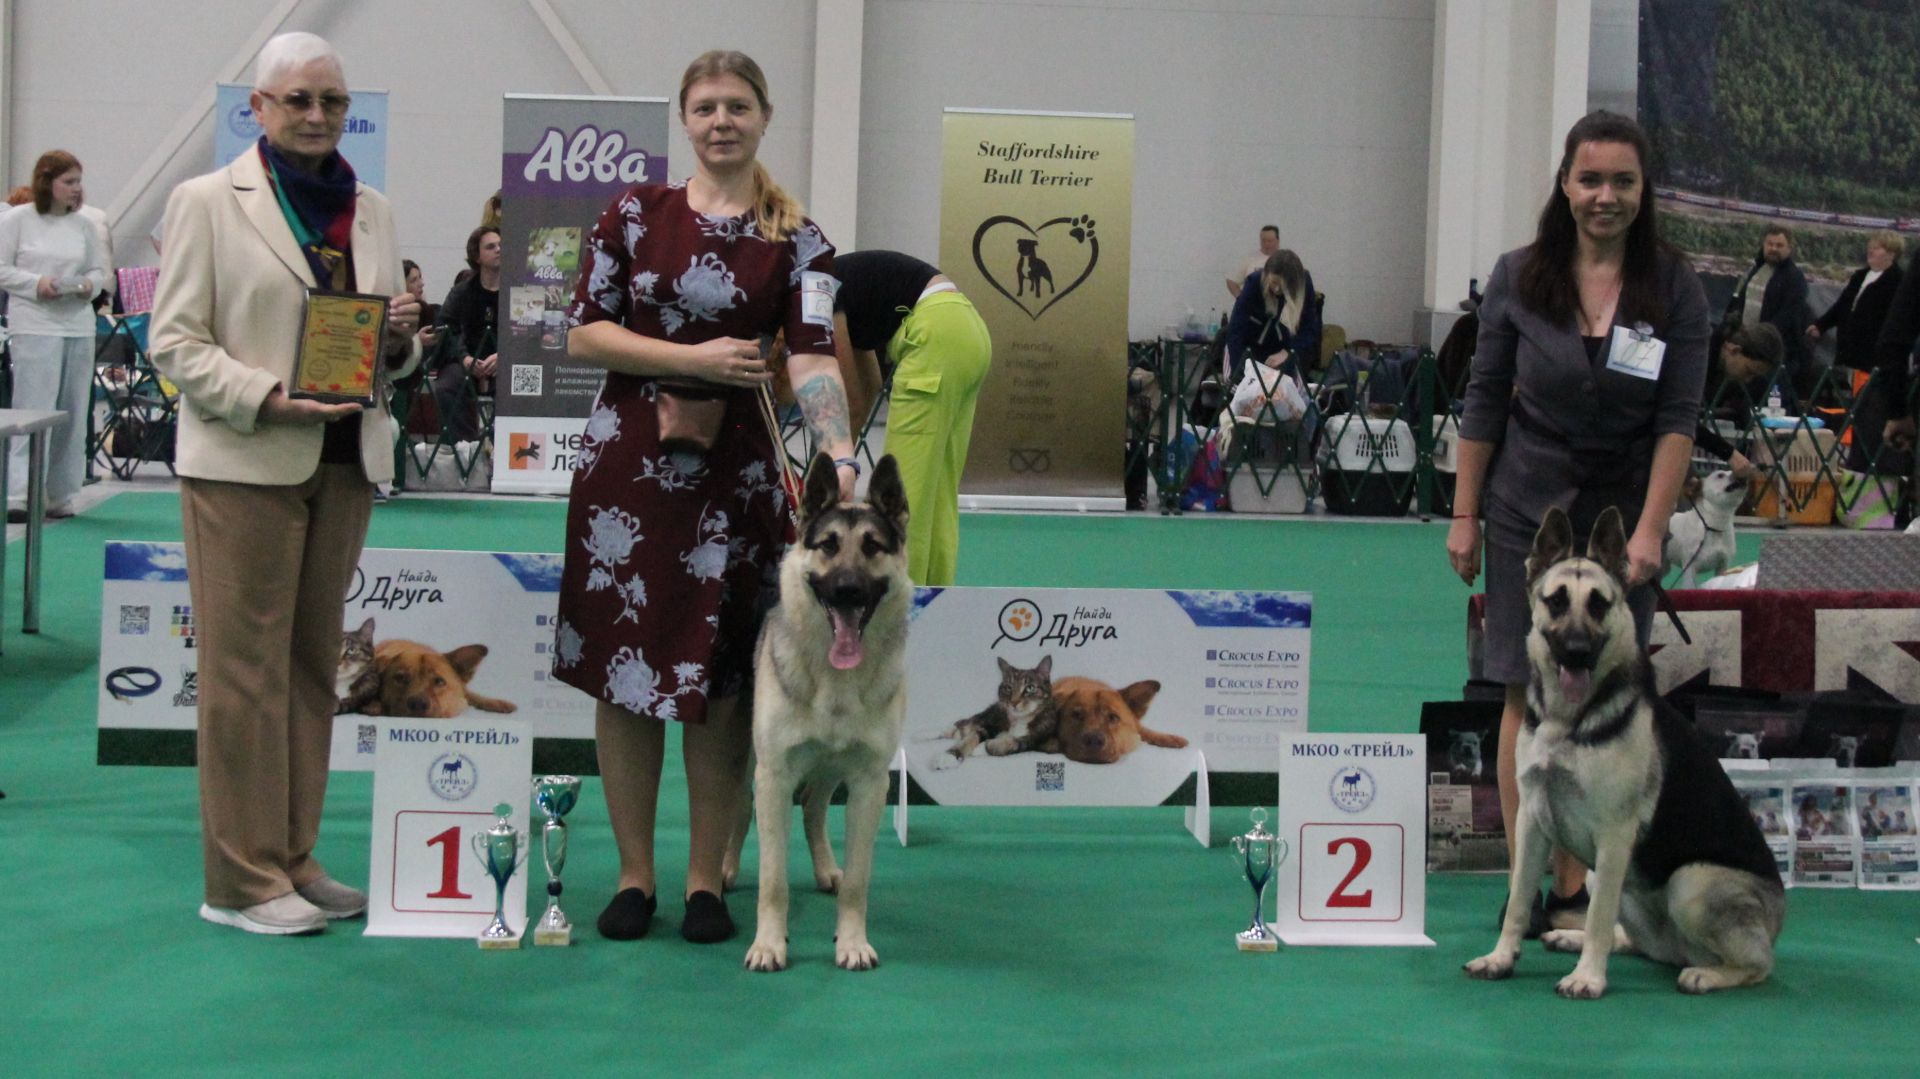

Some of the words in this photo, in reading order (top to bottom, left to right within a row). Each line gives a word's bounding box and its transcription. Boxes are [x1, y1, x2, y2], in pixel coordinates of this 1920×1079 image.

[343, 117, 376, 134] ЕЙЛ»
[524, 127, 649, 183] Авва
[977, 140, 1100, 161] Staffordshire
[983, 167, 1023, 185] Bull
[1029, 168, 1094, 187] Terrier
[553, 433, 584, 451] че
[551, 454, 578, 472] ла
[397, 568, 438, 583] Найди
[361, 576, 443, 610] Друга
[1073, 606, 1112, 621] Найди
[1039, 613, 1118, 648] Друга
[1218, 650, 1264, 661] CROCUS
[1267, 650, 1300, 662] EXPO
[1217, 677, 1263, 689] CROCUS
[1266, 678, 1299, 690] EXPO
[1216, 704, 1262, 717] CROCUS
[1265, 705, 1299, 717] EXPO
[389, 728, 440, 743] МКОО
[444, 728, 520, 745] «ТРЕЙЛ»
[1292, 743, 1339, 757] МКОО
[1343, 741, 1414, 757] «ТРЕЙЛ»
[426, 826, 472, 899] 1
[1325, 837, 1373, 908] 2
